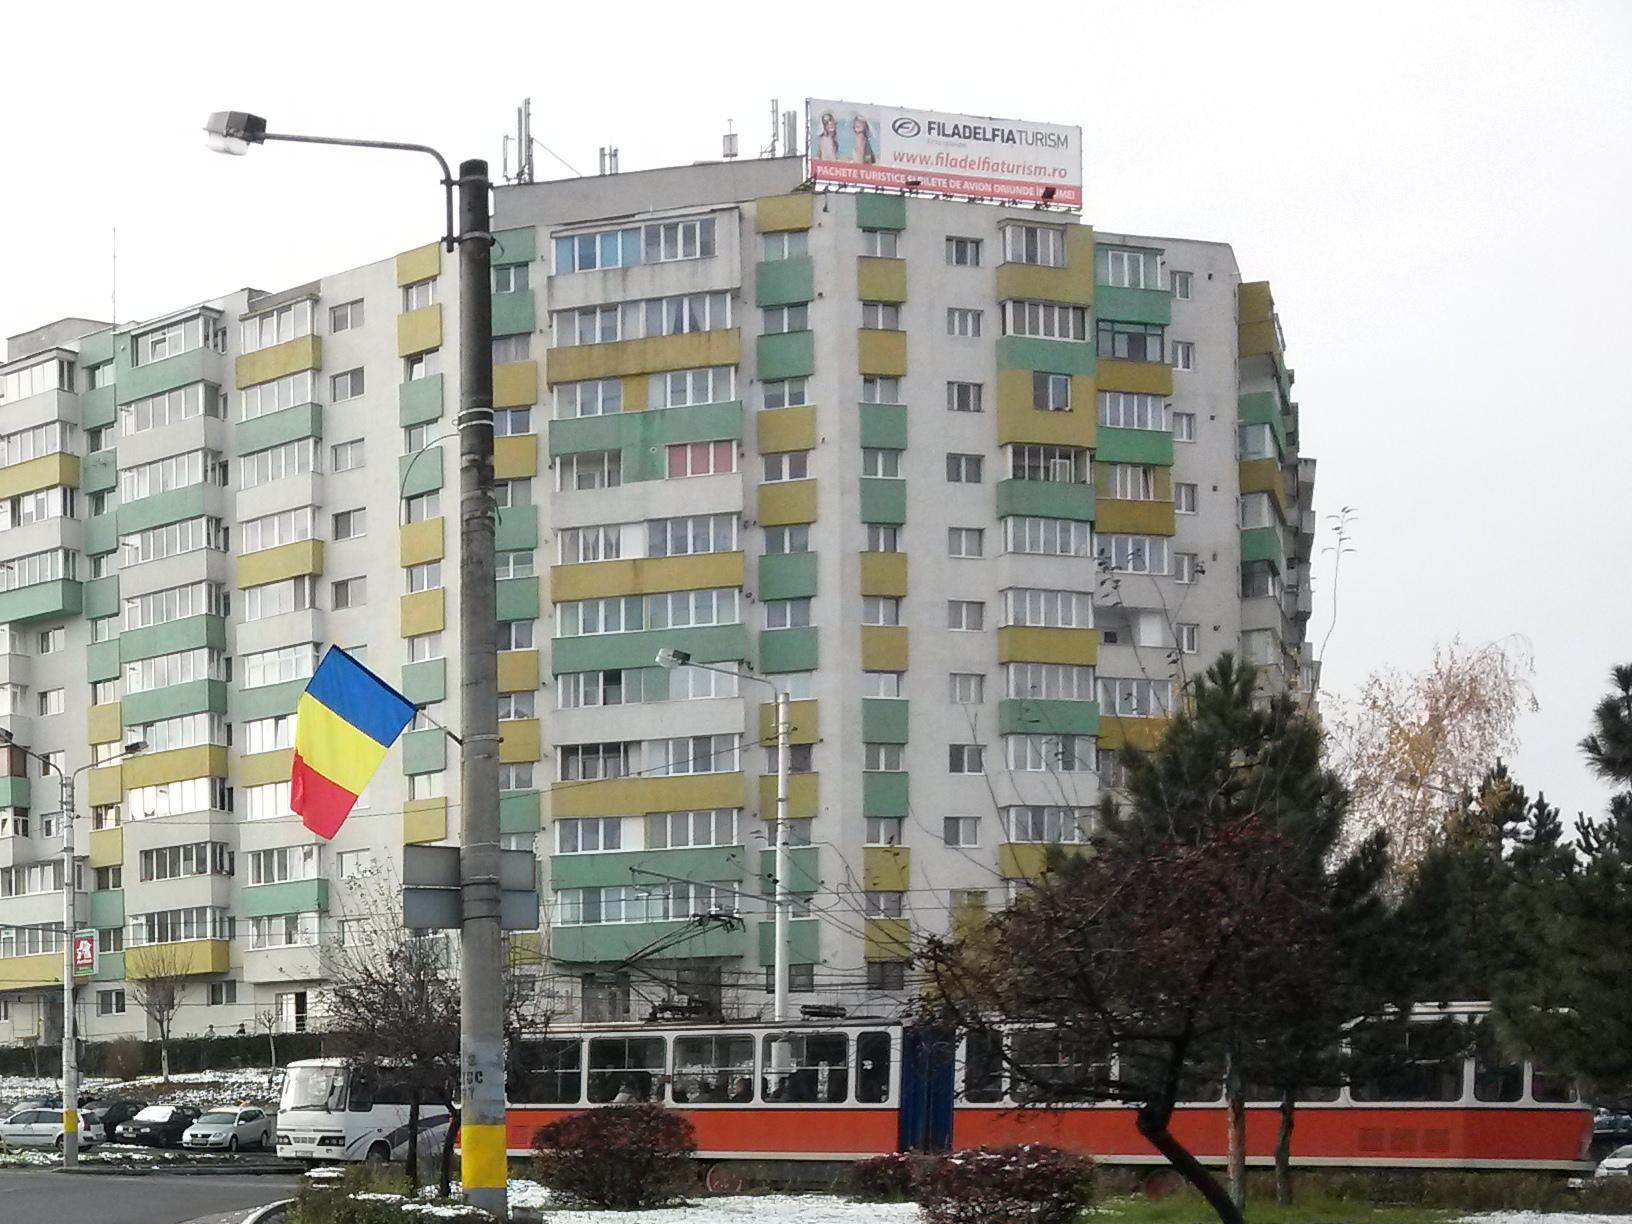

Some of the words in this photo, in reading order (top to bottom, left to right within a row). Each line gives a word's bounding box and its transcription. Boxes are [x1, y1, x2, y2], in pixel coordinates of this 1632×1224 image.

[927, 120, 1069, 150] FILADELFIATURISM
[893, 149, 1068, 179] www.filadelfiaturism.ro
[816, 166, 857, 180] PACHETE
[859, 170, 906, 184] TURISTICE
[948, 179, 961, 190] DE
[961, 180, 992, 194] AVION
[993, 183, 1035, 197] ORIUNDE
